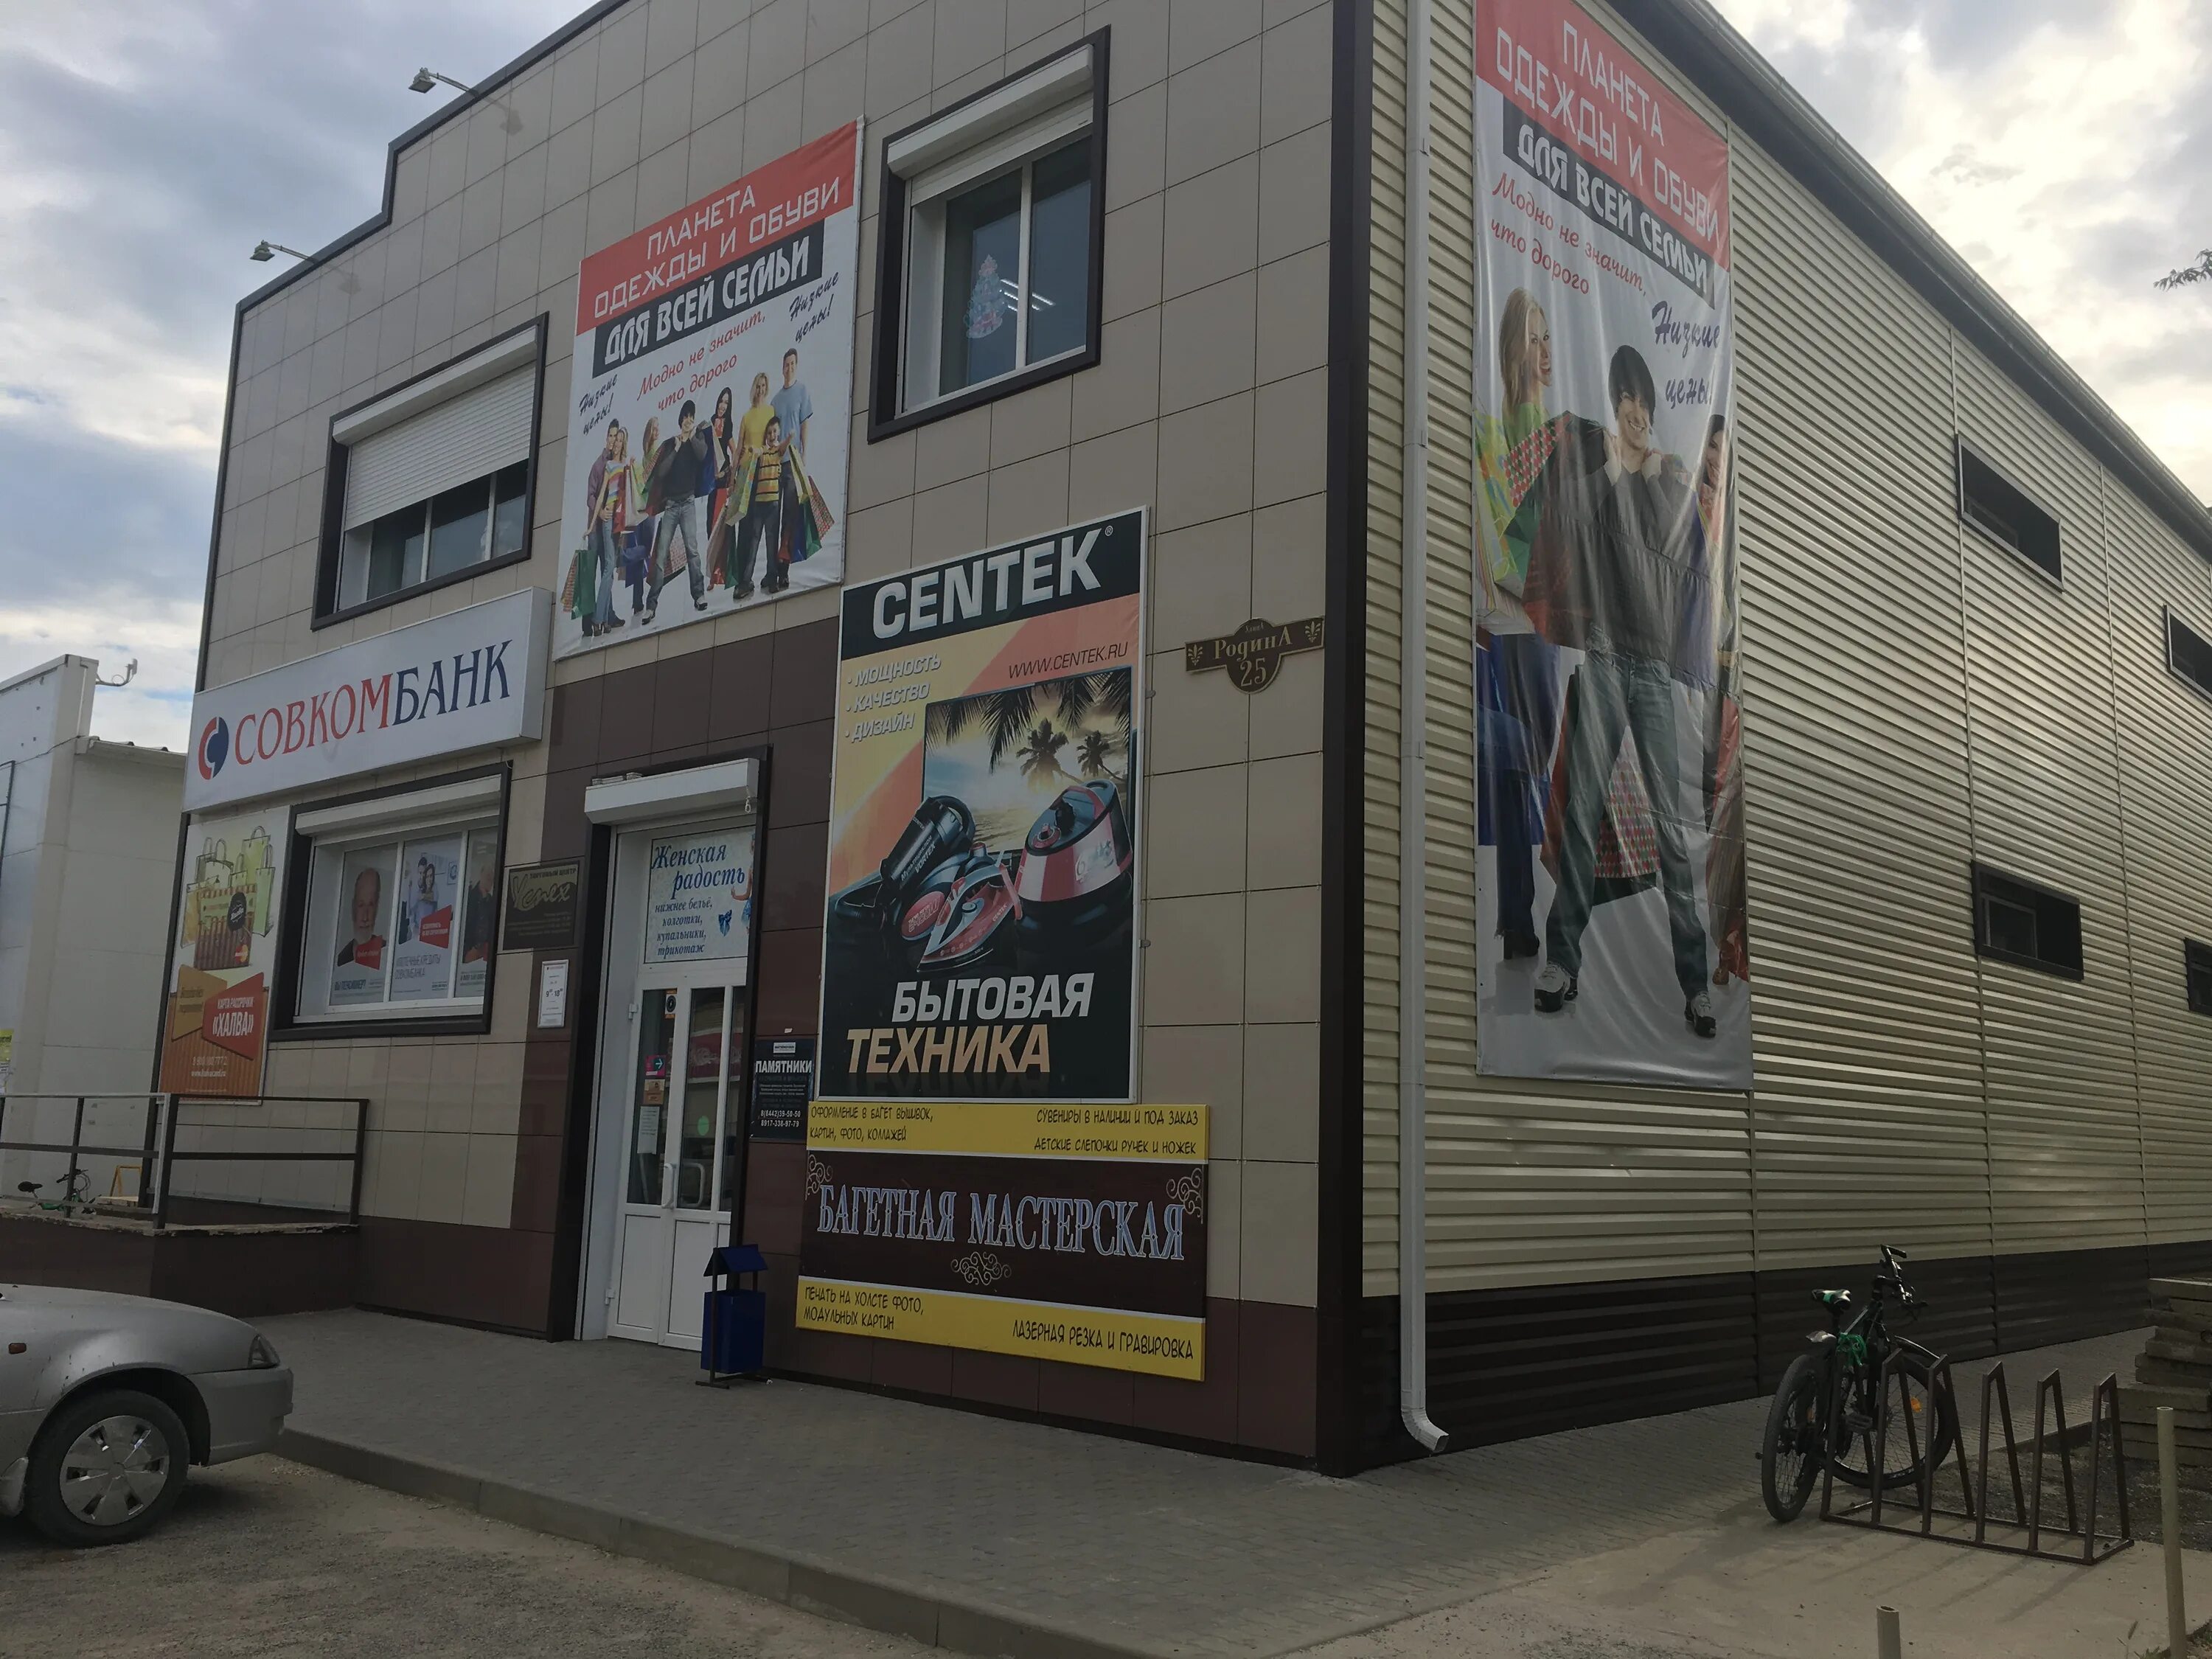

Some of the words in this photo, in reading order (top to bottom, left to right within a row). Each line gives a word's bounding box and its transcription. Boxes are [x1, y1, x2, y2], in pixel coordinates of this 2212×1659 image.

[1563, 19, 1664, 147] ПЛАНЕТА
[1497, 27, 1618, 166] ОДЕЖДЫ
[1629, 136, 1643, 187] И
[1654, 161, 1719, 248] ОБУВИ
[647, 184, 756, 260] ПЛАНЕТА
[1517, 123, 1568, 192] ДЛЯ
[1576, 162, 1633, 238] ВСЕЙ
[1640, 212, 1708, 294] СЕМЬИ
[594, 246, 707, 319] ОДЕЖДЫ
[720, 232, 736, 259] И
[749, 176, 840, 244] ОБУВИ
[1492, 173, 1554, 231] Модно
[1559, 224, 1579, 248] не
[1585, 238, 1646, 296] значит,
[1490, 218, 1526, 254] что
[1531, 238, 1590, 295] дорого
[605, 310, 650, 365] ДЛЯ
[655, 275, 714, 341] ВСЕЙ
[723, 236, 810, 310] СЕМЬИ
[789, 271, 839, 321] Низкие
[795, 293, 835, 343] цены!
[1651, 300, 1720, 358] Низкие
[637, 361, 684, 401] Модно
[689, 347, 705, 365] не
[709, 310, 766, 354] значит,
[579, 374, 618, 417] Низкие
[658, 387, 684, 411] что
[689, 354, 737, 393] дорого
[582, 392, 615, 436] цены!
[872, 528, 1102, 639] CENTEK
[854, 653, 942, 687] МОЩНОСТЬ
[1008, 641, 1129, 679] WWW.CENTEK.RU
[1240, 658, 1266, 686] 25
[234, 639, 513, 765] СОВКОМБАНК
[852, 683, 931, 713] КАЧЕСТВО
[850, 711, 915, 743] ДИЗАЙН
[650, 844, 727, 869] Женская
[670, 864, 745, 900] радость
[655, 901, 686, 914] нижнее
[662, 915, 703, 927] колготки,
[657, 930, 706, 945] купальники,
[658, 944, 705, 959] трикотаж
[892, 973, 1094, 1023] БЫТОВАЯ
[212, 1012, 254, 1037] «ХАЛВА»
[755, 1060, 813, 1074] ПАМЯТНИКИ
[846, 1024, 1051, 1074] ТЕХНИКА
[760, 1110, 801, 1119] 8(8442)39-50-50
[810, 1127, 837, 1141] КАРТИН,
[840, 1128, 864, 1142] ФОТО,
[867, 1125, 907, 1141] КОЛЛАЖЕЙ
[811, 1106, 858, 1119] ОФОРМЛЕНИЕ
[862, 1107, 867, 1119] В
[870, 1107, 892, 1119] БАГЕТ
[896, 1107, 933, 1122] ВЫШИВОК,
[1036, 1108, 1082, 1124] СУВЕНИРЫ
[1085, 1110, 1091, 1124] В
[1093, 1110, 1131, 1124] НАЛИЧИИ
[1144, 1110, 1164, 1125] ПОД
[1168, 1110, 1198, 1125] ЗАКАЗ
[1034, 1138, 1071, 1151] ДЕТСКИЕ
[1075, 1138, 1118, 1152] СЛЕПОЧКИ
[1121, 1140, 1149, 1153] РУЧЕК
[1152, 1141, 1158, 1153] И
[1162, 1141, 1196, 1154] НОЖЕК
[817, 1183, 957, 1242] БАГЕТНАЯ
[967, 1192, 1186, 1261] МАСТЕРСКАЯ
[803, 1307, 858, 1326] МОДУЛЬНЫХ
[861, 1313, 894, 1330] КАРТИН
[804, 1287, 836, 1303] ПЕЧАТЬ
[839, 1290, 851, 1304] НА
[855, 1291, 888, 1309] ХОЛСТЕ
[892, 1295, 924, 1315] ФОТО,
[1012, 1319, 1065, 1343] ЛАЗЕРНАЯ
[1069, 1326, 1102, 1348] РЕЗКА
[1107, 1331, 1115, 1349] И
[1119, 1332, 1194, 1360] ГРАВИРОВКА
